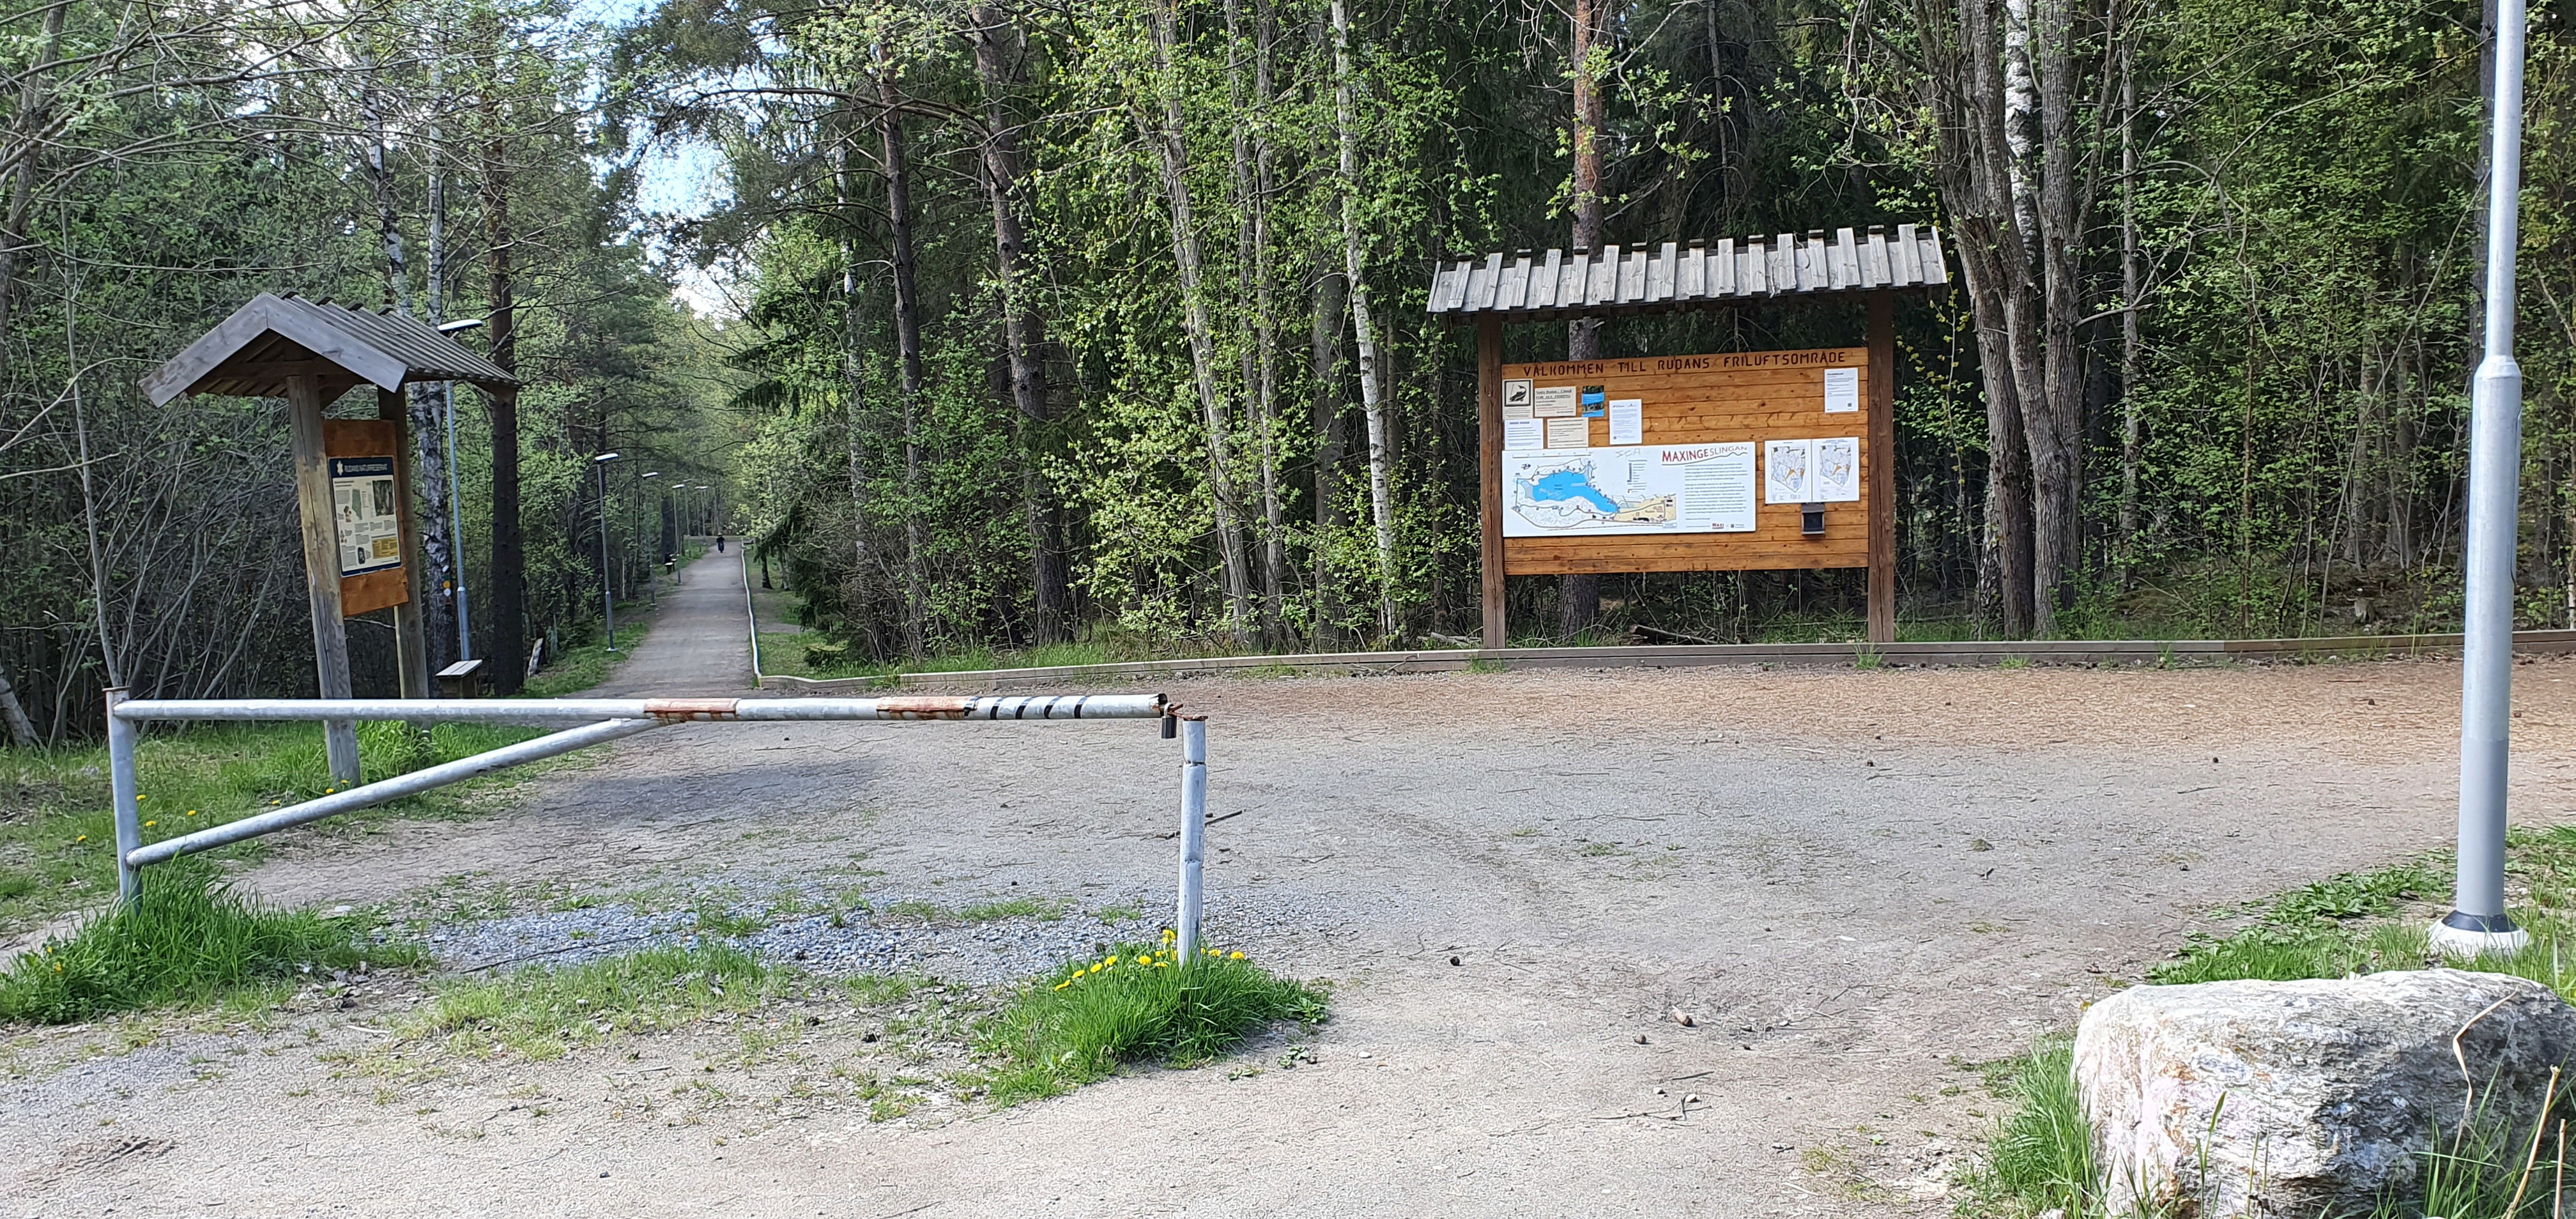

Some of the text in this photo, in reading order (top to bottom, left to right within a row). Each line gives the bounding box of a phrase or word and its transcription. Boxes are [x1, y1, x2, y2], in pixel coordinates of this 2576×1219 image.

[1523, 362, 1604, 377] VÄLKOMMEN
[1618, 361, 1646, 372] TILL
[1657, 357, 1710, 371] RUDANS
[1661, 446, 1747, 463] MAXINGESLINGAN
